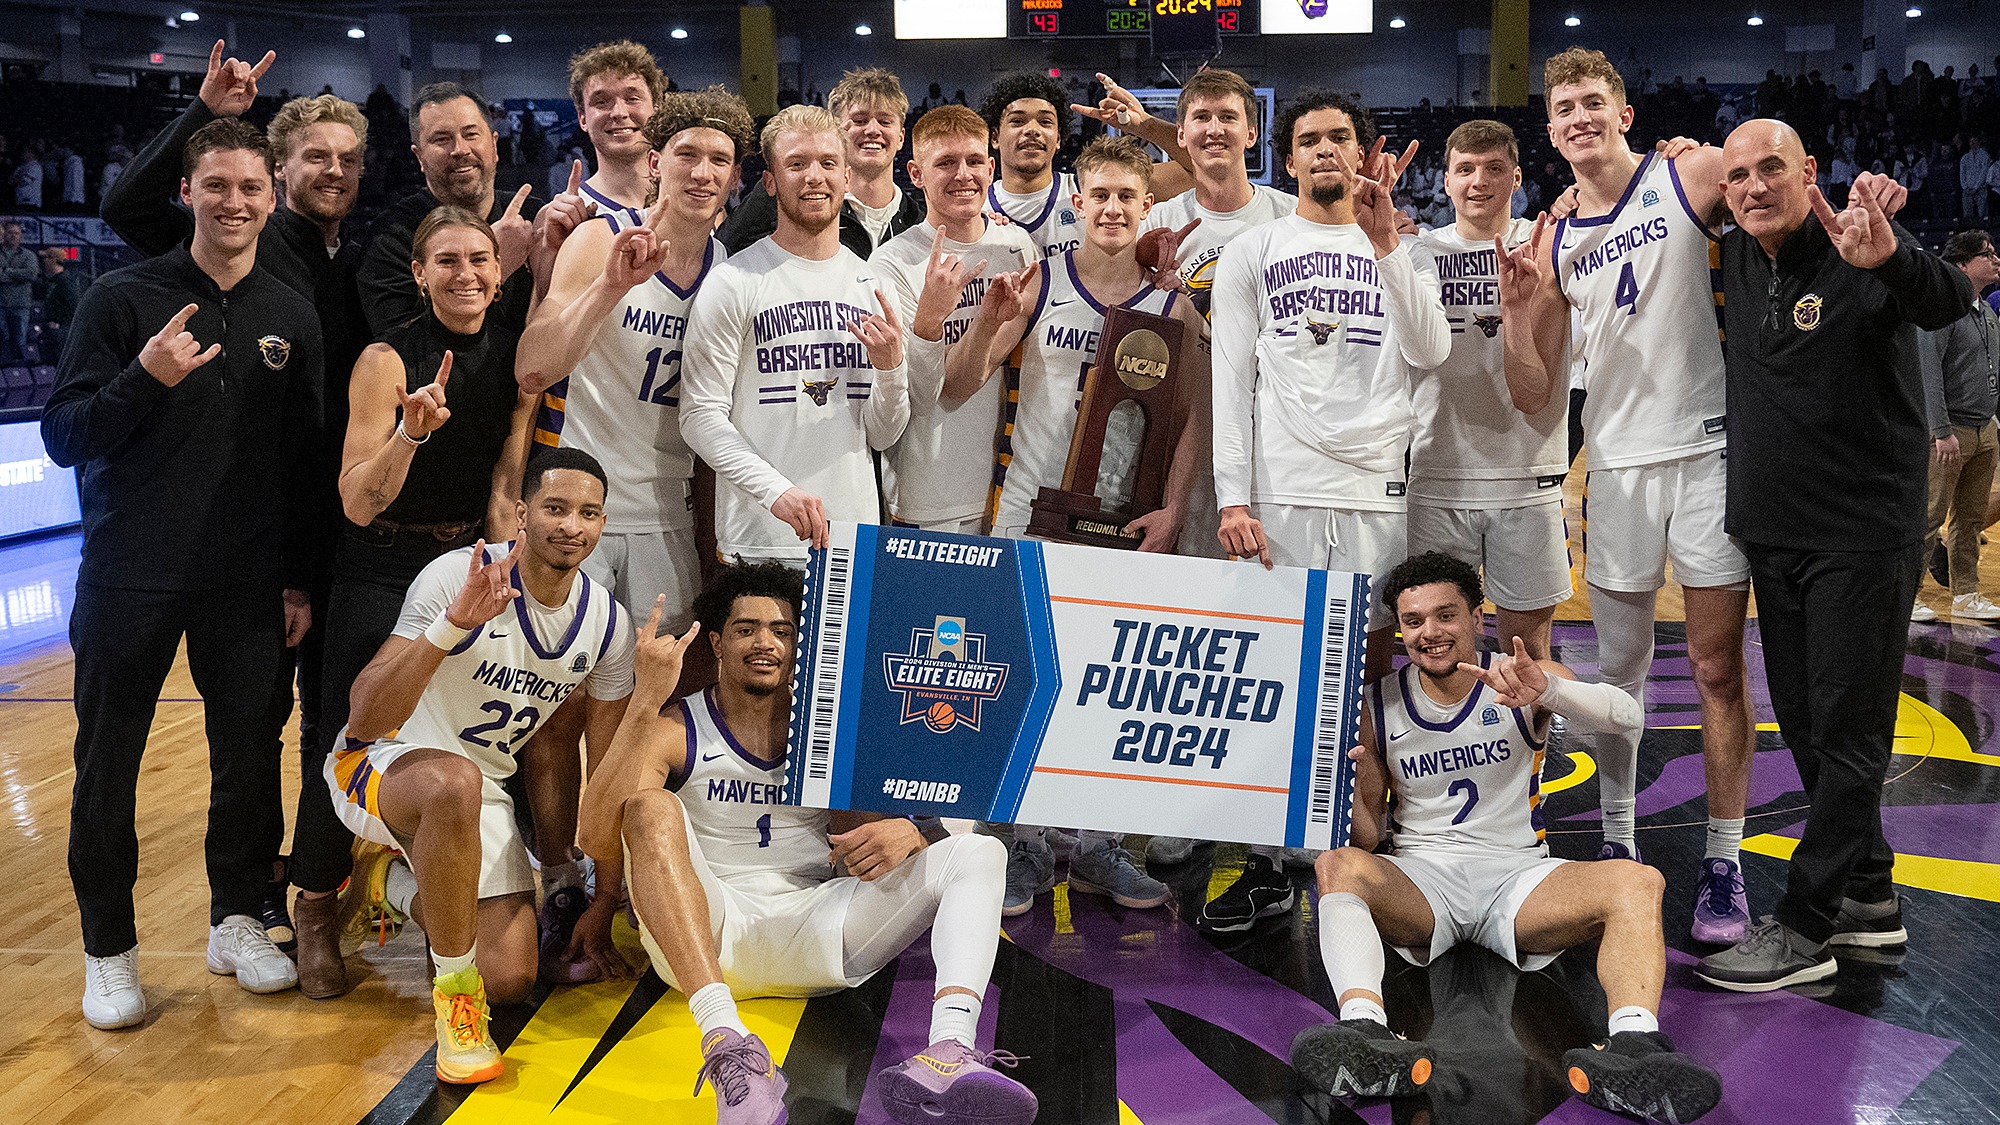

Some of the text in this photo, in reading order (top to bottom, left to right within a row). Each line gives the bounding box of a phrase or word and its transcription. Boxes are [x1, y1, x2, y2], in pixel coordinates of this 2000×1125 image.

[1033, 13, 1057, 32] 43
[1109, 11, 1151, 29] 20:2
[1572, 217, 1669, 281] MAVERICKS
[1264, 251, 1342, 296] MINNESOTA
[1615, 261, 1640, 316] 4
[1269, 286, 1385, 320] BASKETBALL
[754, 300, 833, 346] MINNESOTA
[638, 346, 683, 407] 12
[1119, 355, 1167, 379] NCAA
[1075, 519, 1118, 536] REGIONAL
[886, 537, 1003, 568] #ELITEEIGHT
[938, 631, 961, 640] NCAA
[1111, 619, 1260, 674] TICKET
[472, 660, 577, 703] MAVERICKS
[896, 664, 997, 690] ELITE EIGHT
[903, 657, 922, 665] 2024
[924, 660, 957, 669] DIVISION
[967, 664, 989, 672] MEN'S
[916, 691, 960, 701] EVANSVILLE,
[1076, 663, 1284, 723] PUNCHED
[458, 699, 541, 755] 23
[1112, 719, 1231, 769] 2024
[1400, 738, 1511, 780] MAVERICKS
[882, 778, 962, 803] #D2MBB
[1447, 778, 1480, 826] 2
[756, 813, 772, 849] 1
